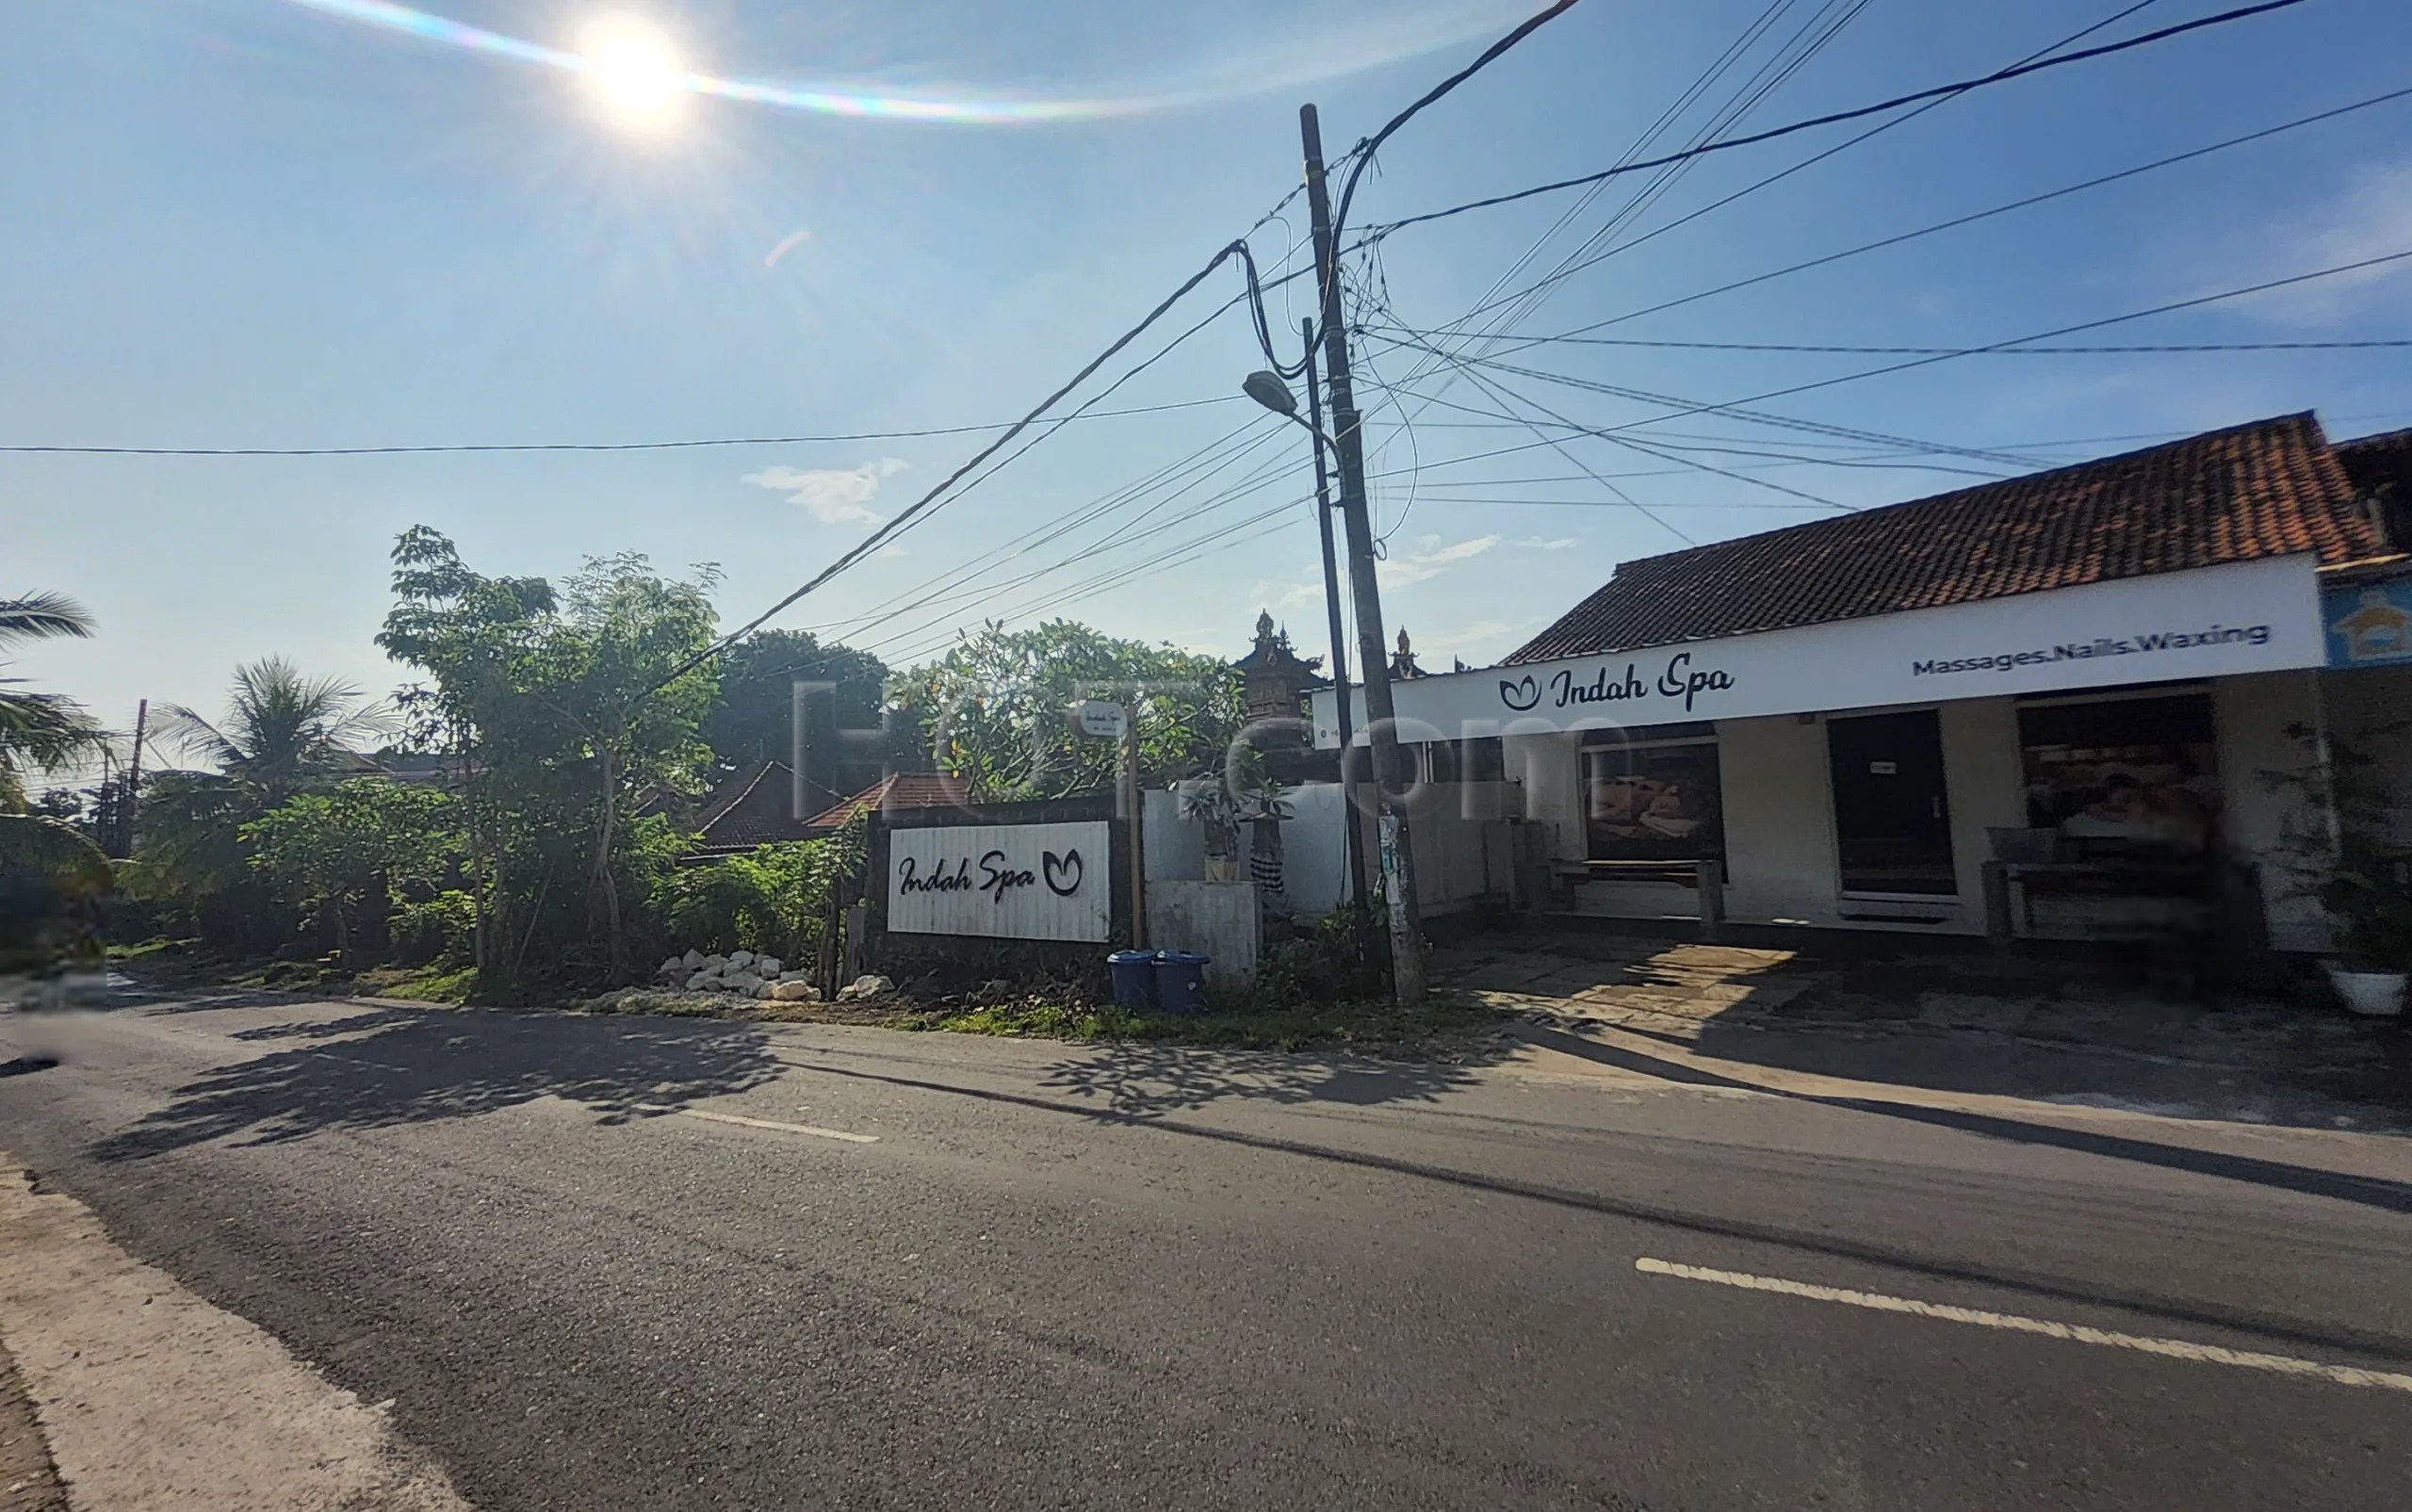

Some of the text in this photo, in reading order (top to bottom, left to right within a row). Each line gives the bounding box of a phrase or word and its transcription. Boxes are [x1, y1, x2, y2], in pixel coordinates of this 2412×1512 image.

[1550, 652, 1736, 712] Indah Spa
[899, 850, 1035, 904] Indah Spa
